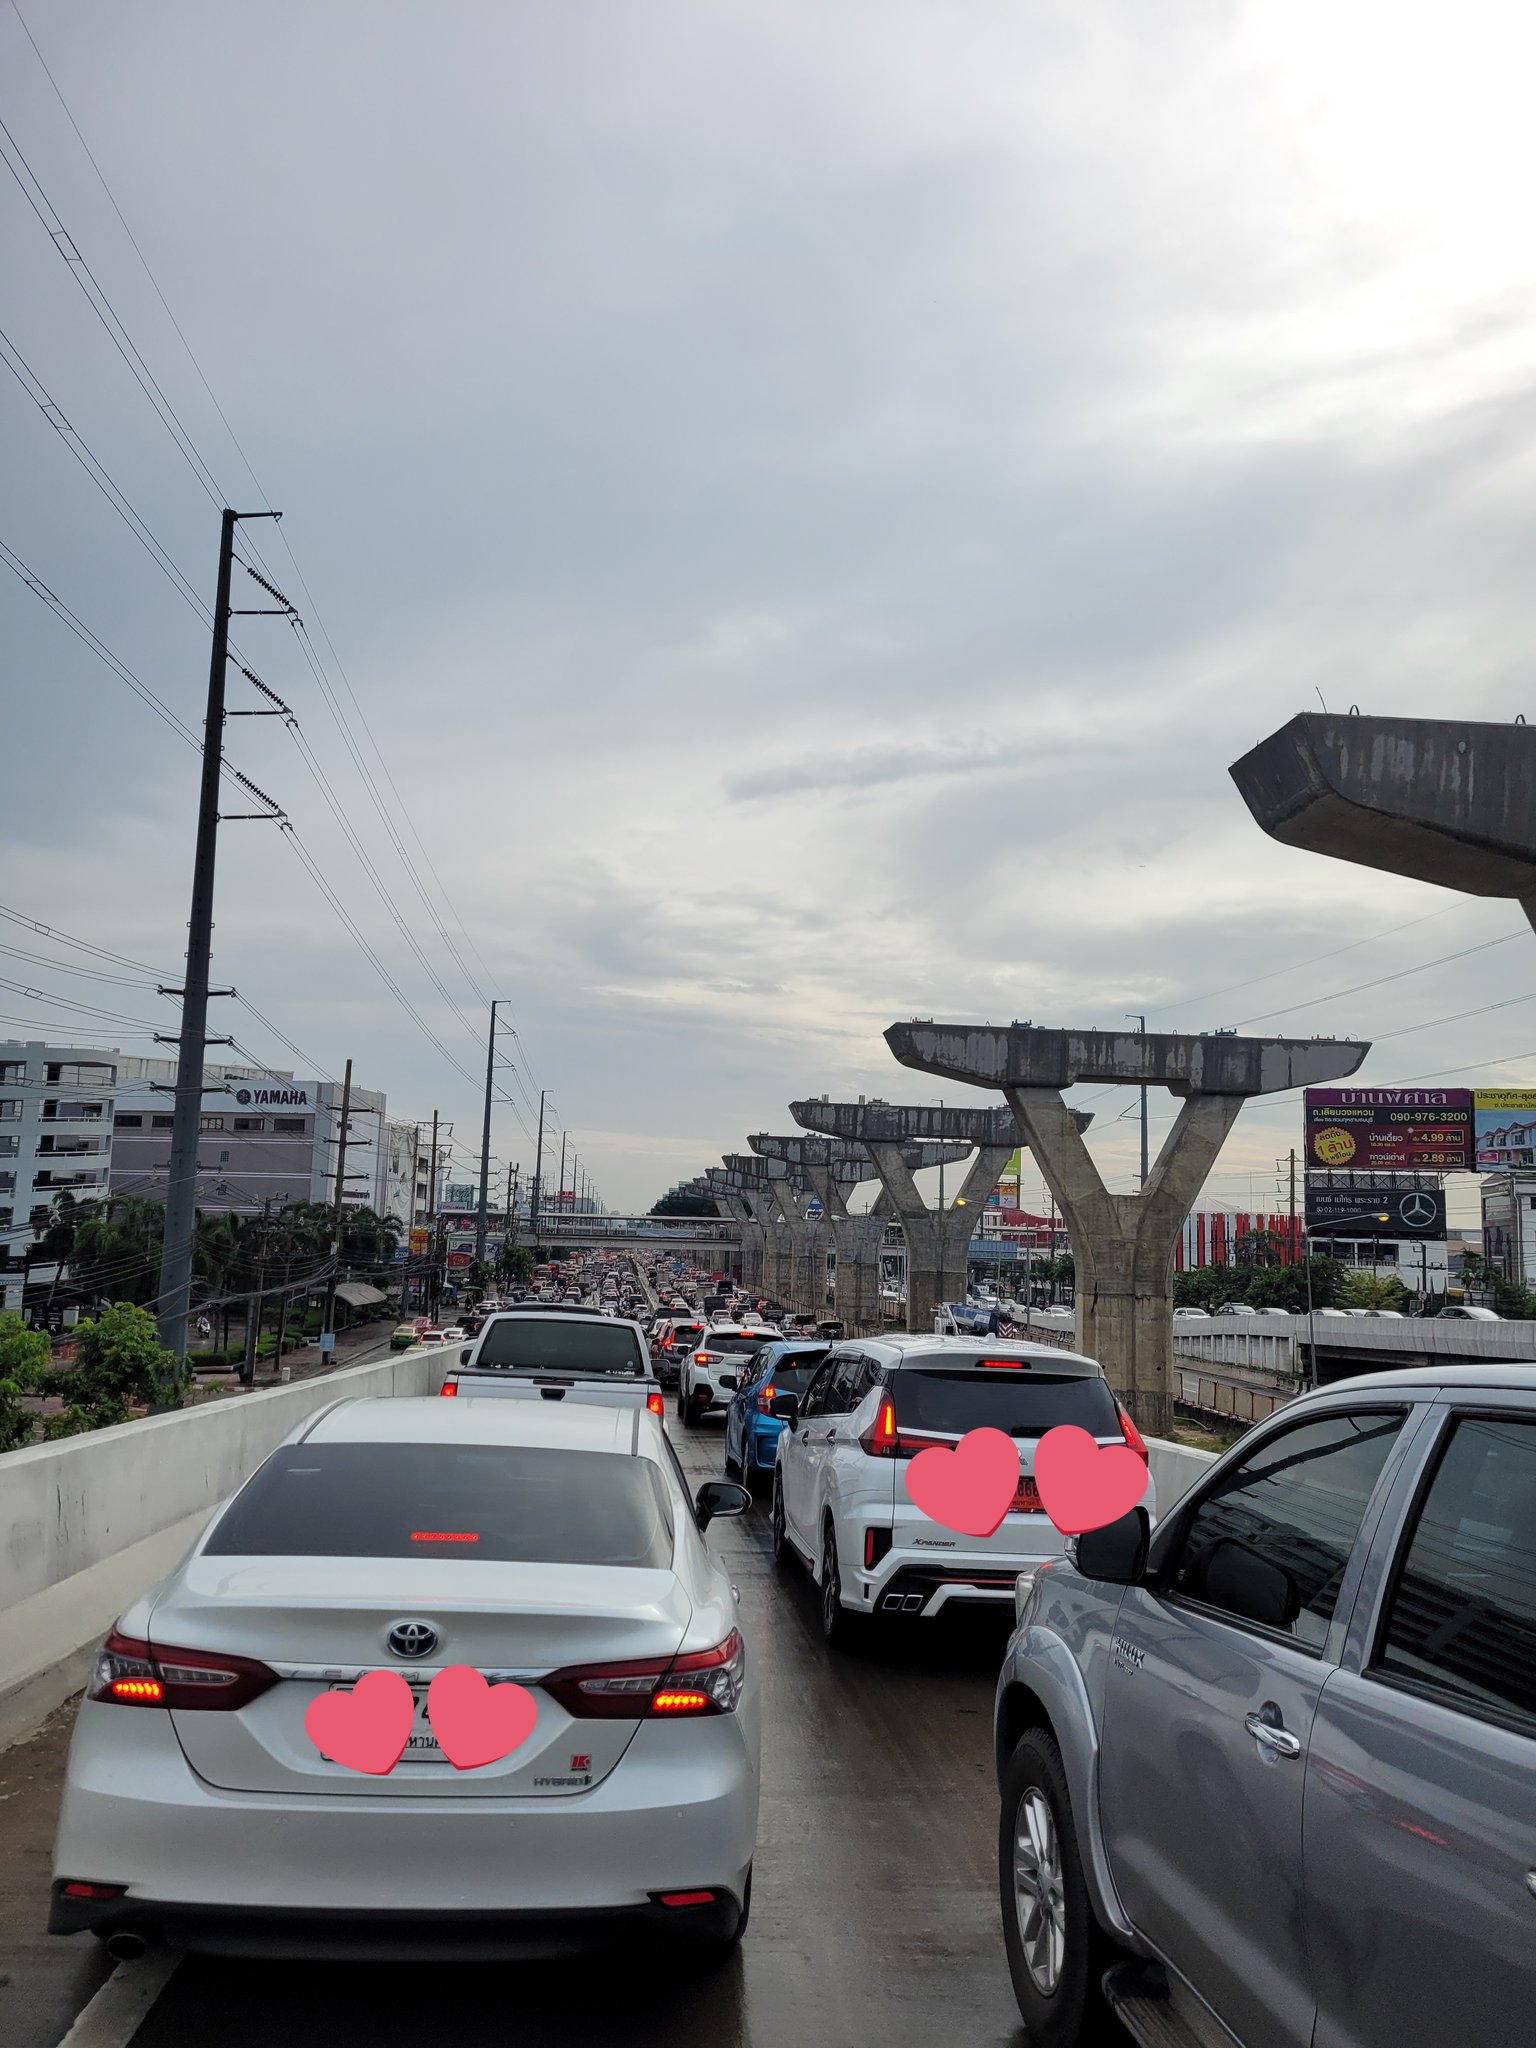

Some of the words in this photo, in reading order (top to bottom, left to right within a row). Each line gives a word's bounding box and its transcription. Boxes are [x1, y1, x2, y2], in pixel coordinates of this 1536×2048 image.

[254, 1089, 308, 1105] YAMAHA
[1390, 1112, 1467, 1121] 090-976-3200
[1369, 1132, 1403, 1142] บ้านเดี่ยว
[1421, 1133, 1444, 1142] 4.99
[1445, 1133, 1460, 1142] ล้าน
[1317, 1145, 1325, 1156] 1
[1328, 1138, 1353, 1153] ล้าน
[1422, 1153, 1445, 1163] 2.89
[1383, 1196, 1388, 1204] 2
[912, 1538, 956, 1547] XPANDER
[1115, 1636, 1145, 1670] HILUX
[534, 1776, 583, 1786] HYBRID
